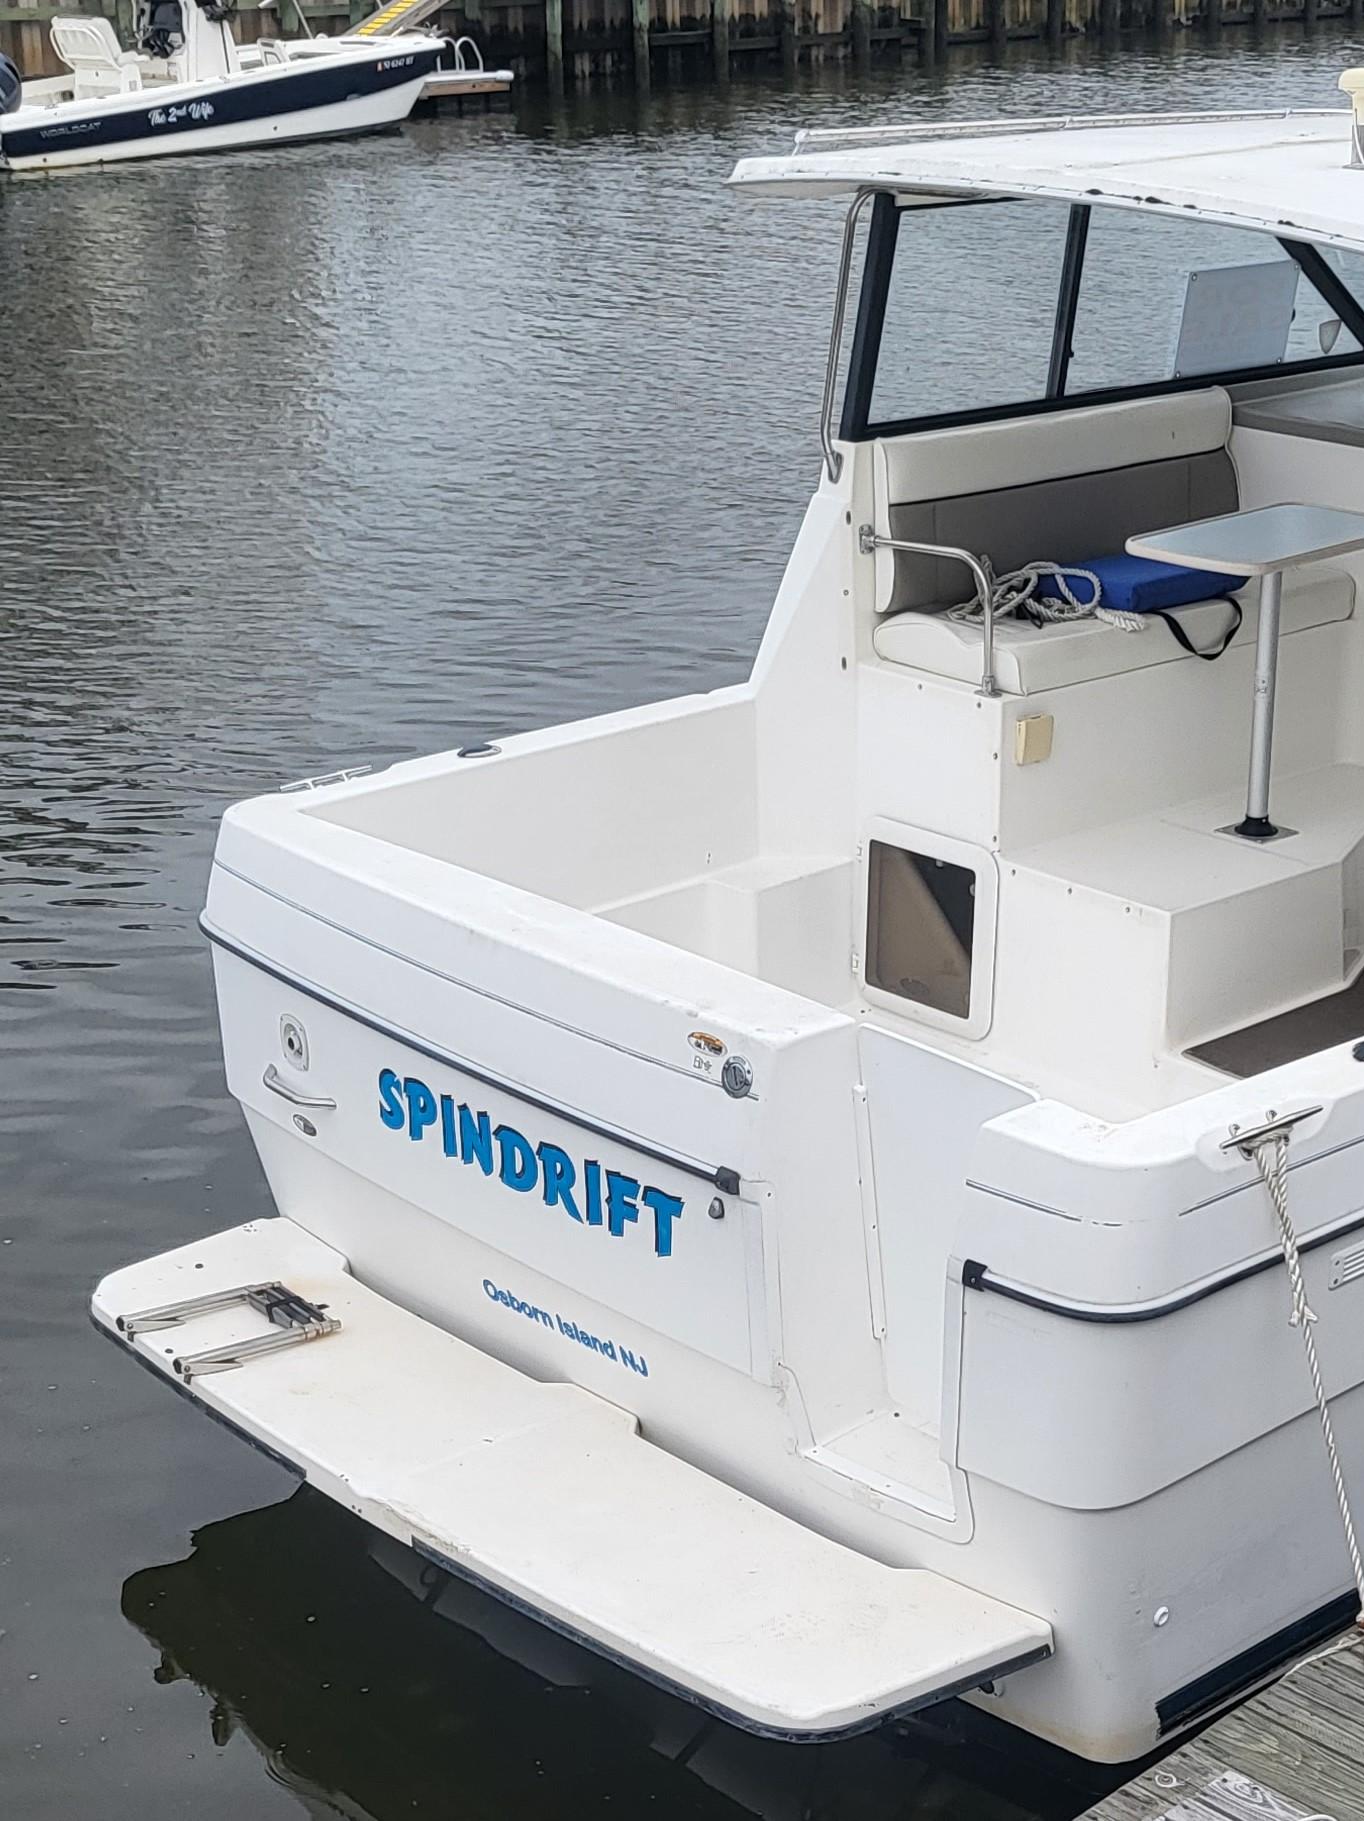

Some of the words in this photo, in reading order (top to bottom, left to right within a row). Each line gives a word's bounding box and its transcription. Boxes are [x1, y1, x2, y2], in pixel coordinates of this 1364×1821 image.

[148, 109, 166, 127] The
[188, 101, 215, 121] Wife
[377, 1068, 685, 1258] SPINDRIFT
[482, 1279, 555, 1330] Osborn
[556, 1313, 618, 1362] Island
[618, 1345, 649, 1378] NJ
